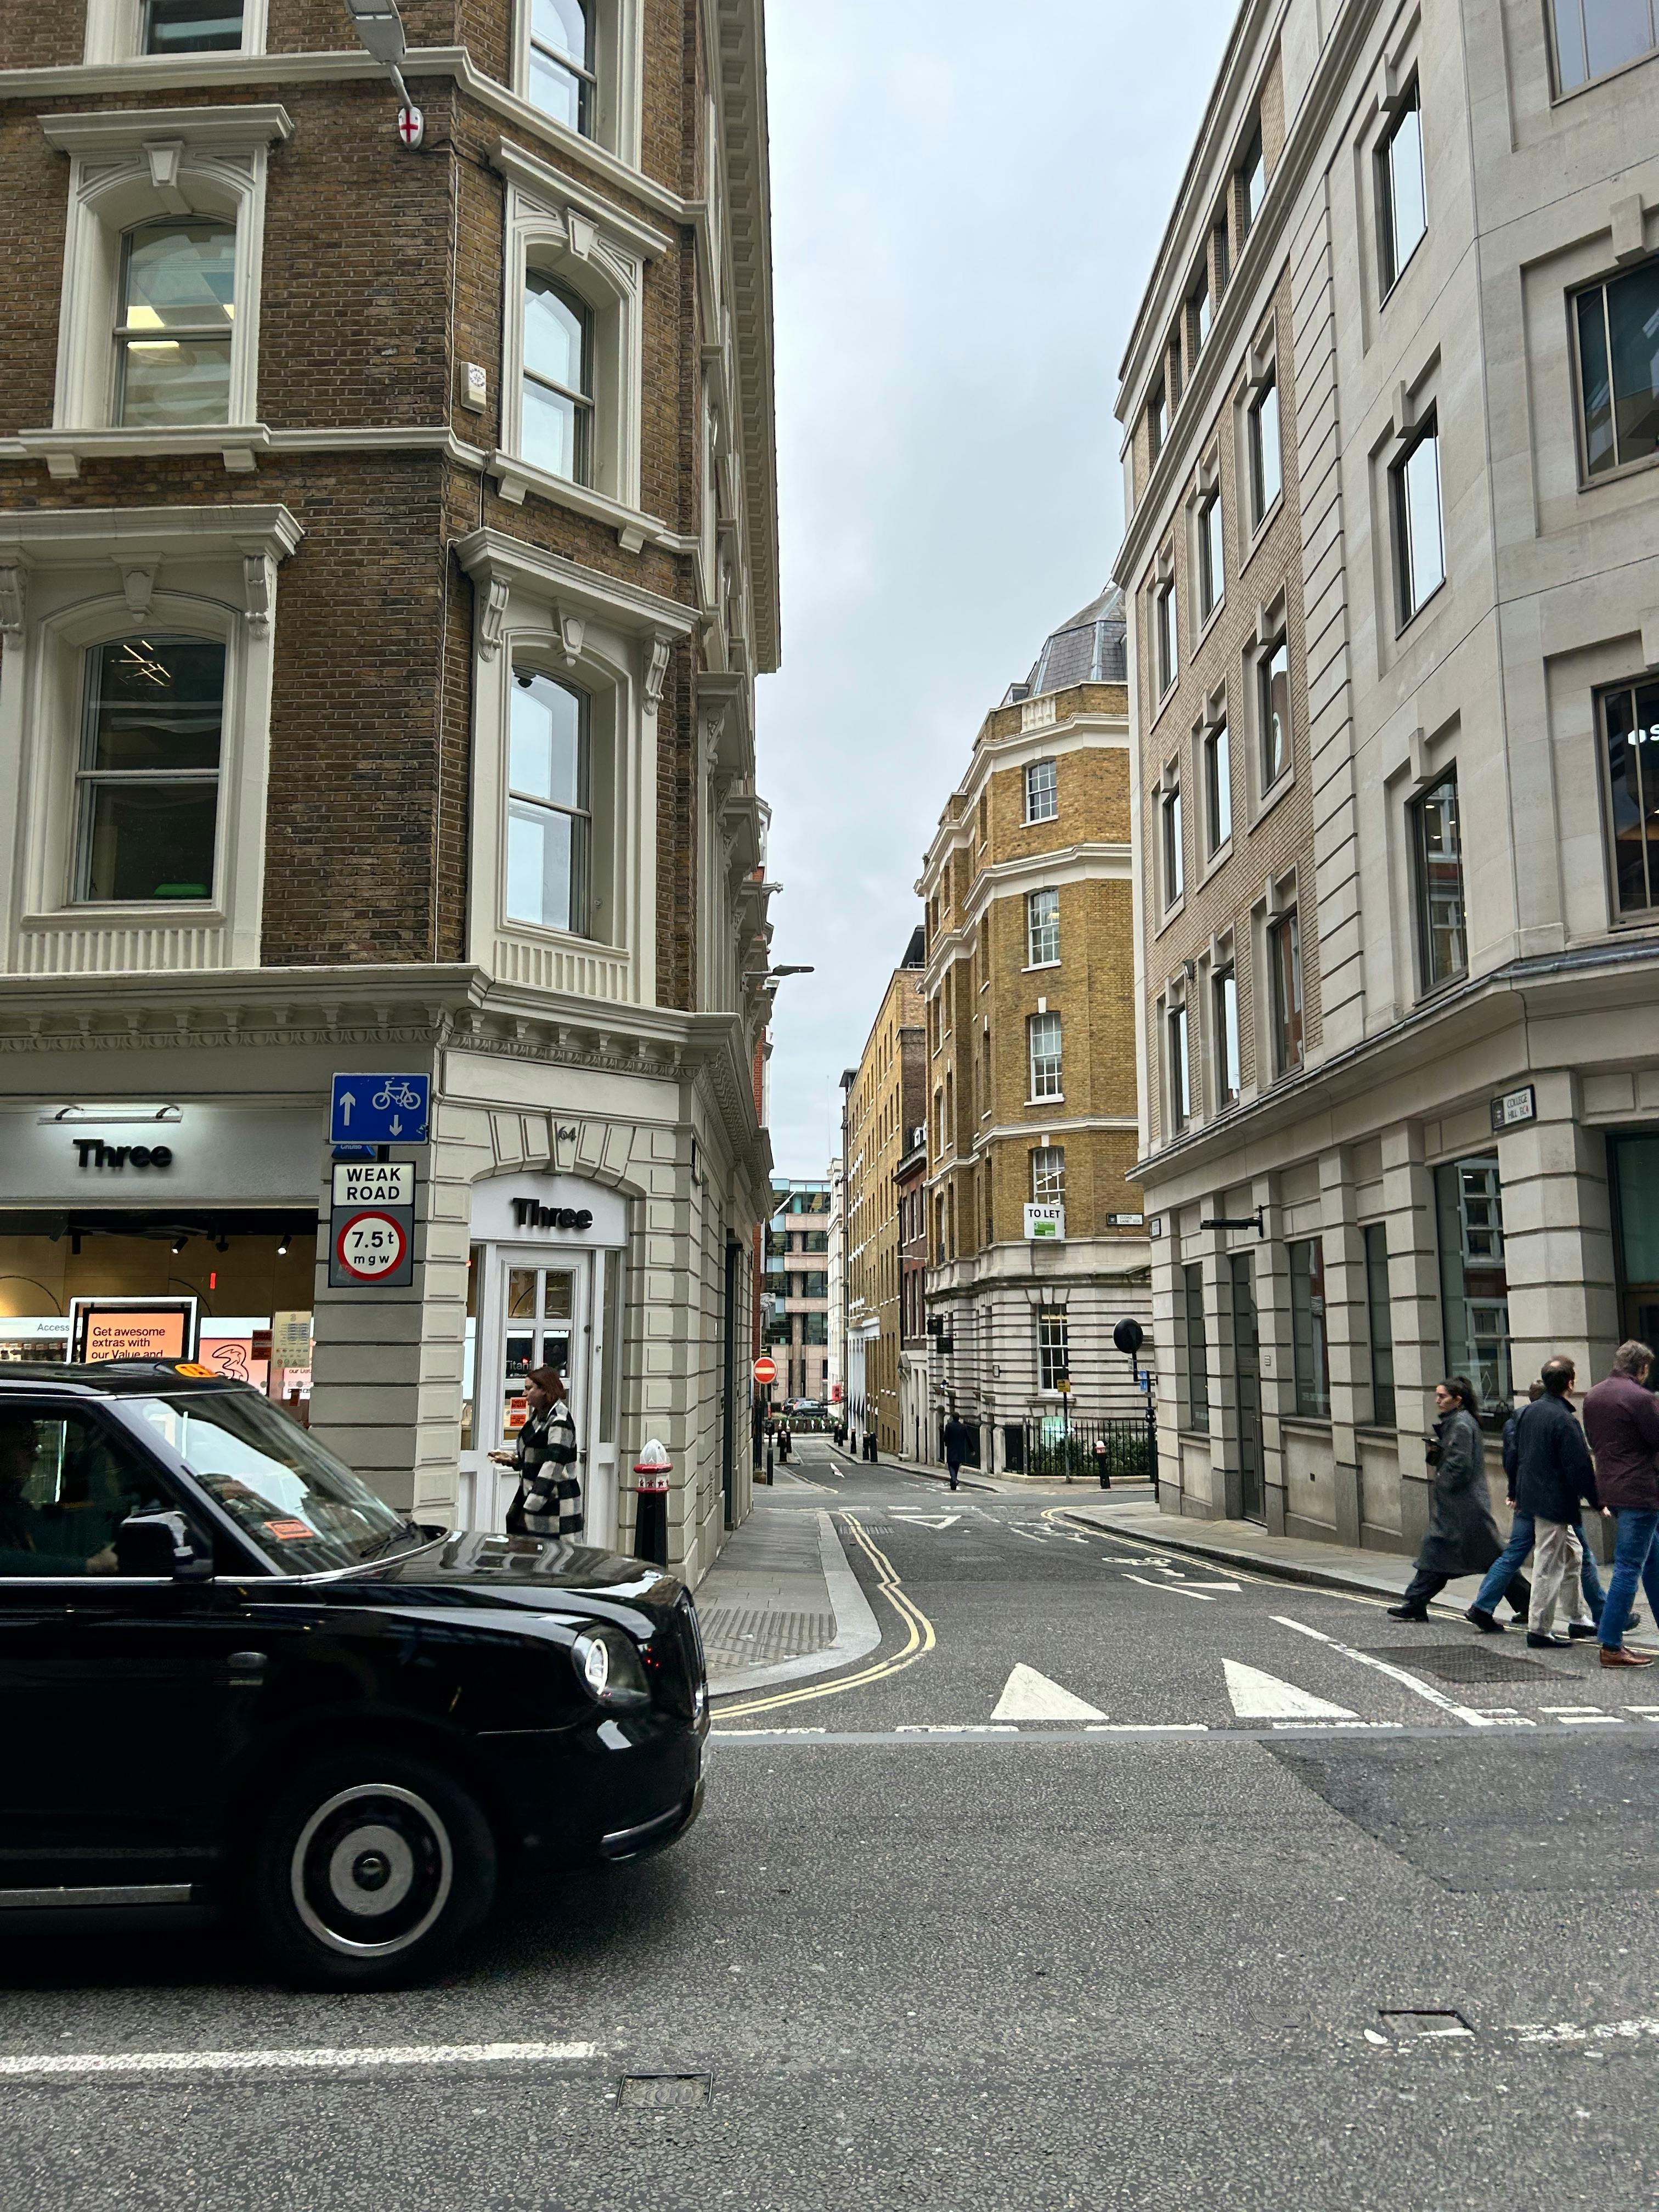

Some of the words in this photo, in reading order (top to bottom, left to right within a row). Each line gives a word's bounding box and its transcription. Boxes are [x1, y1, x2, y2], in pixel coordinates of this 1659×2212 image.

[1507, 1093, 1527, 1108] COLLEGE
[1508, 1109, 1517, 1120] HILL
[558, 1126, 576, 1142] 64
[73, 1139, 172, 1167] Three
[347, 1167, 401, 1182] WEAK
[347, 1186, 400, 1200] ROAD
[513, 1198, 593, 1229] Three
[1028, 1209, 1041, 1217] TO
[1044, 1209, 1060, 1218] LET
[93, 1327, 111, 1336] Get
[114, 1328, 166, 1336] awesome
[92, 1339, 125, 1347] extras
[128, 1338, 150, 1347] with
[112, 1350, 140, 1358] Value
[143, 1350, 163, 1358] and
[506, 1360, 532, 1370] Titani
